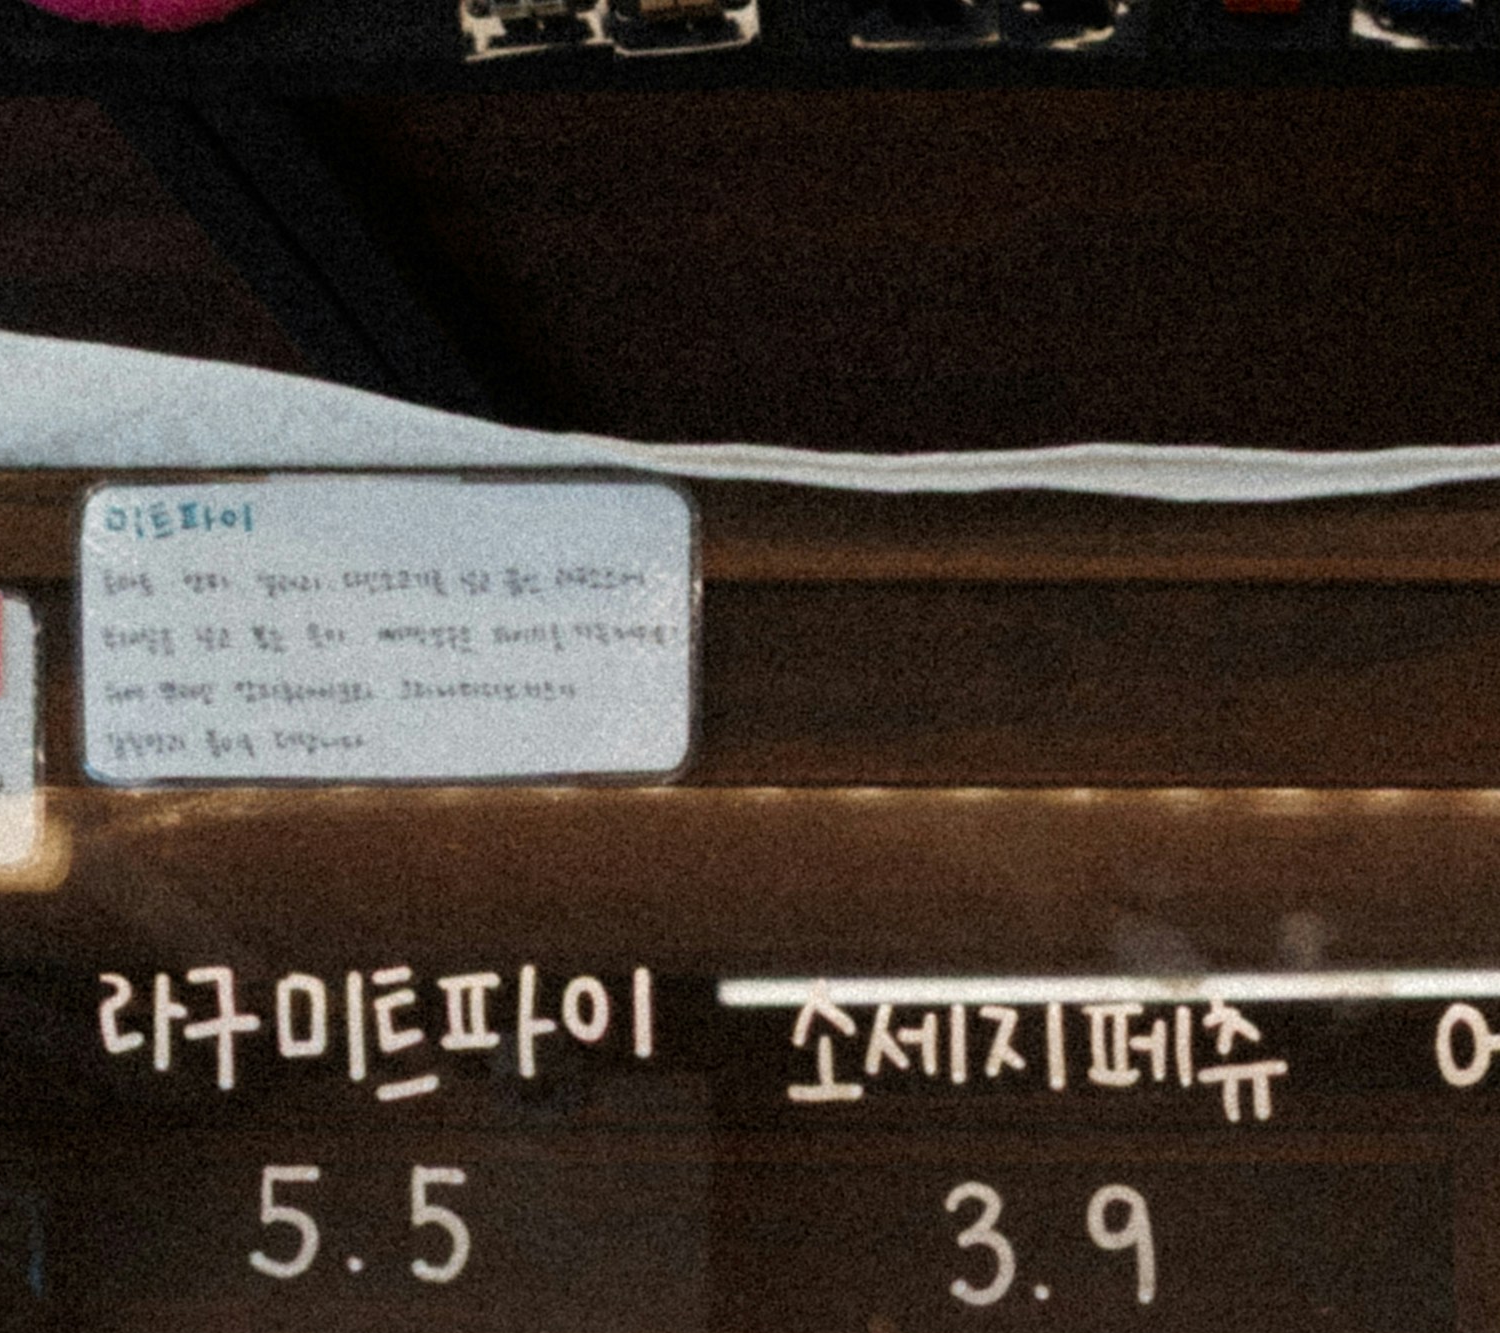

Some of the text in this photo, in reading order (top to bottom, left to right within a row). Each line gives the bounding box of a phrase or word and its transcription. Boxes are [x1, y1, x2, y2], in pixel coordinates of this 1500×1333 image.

[97, 963, 654, 1101] 라구미트파이
[248, 1164, 472, 1283] 5.5
[943, 1181, 1158, 1305] 3.9
